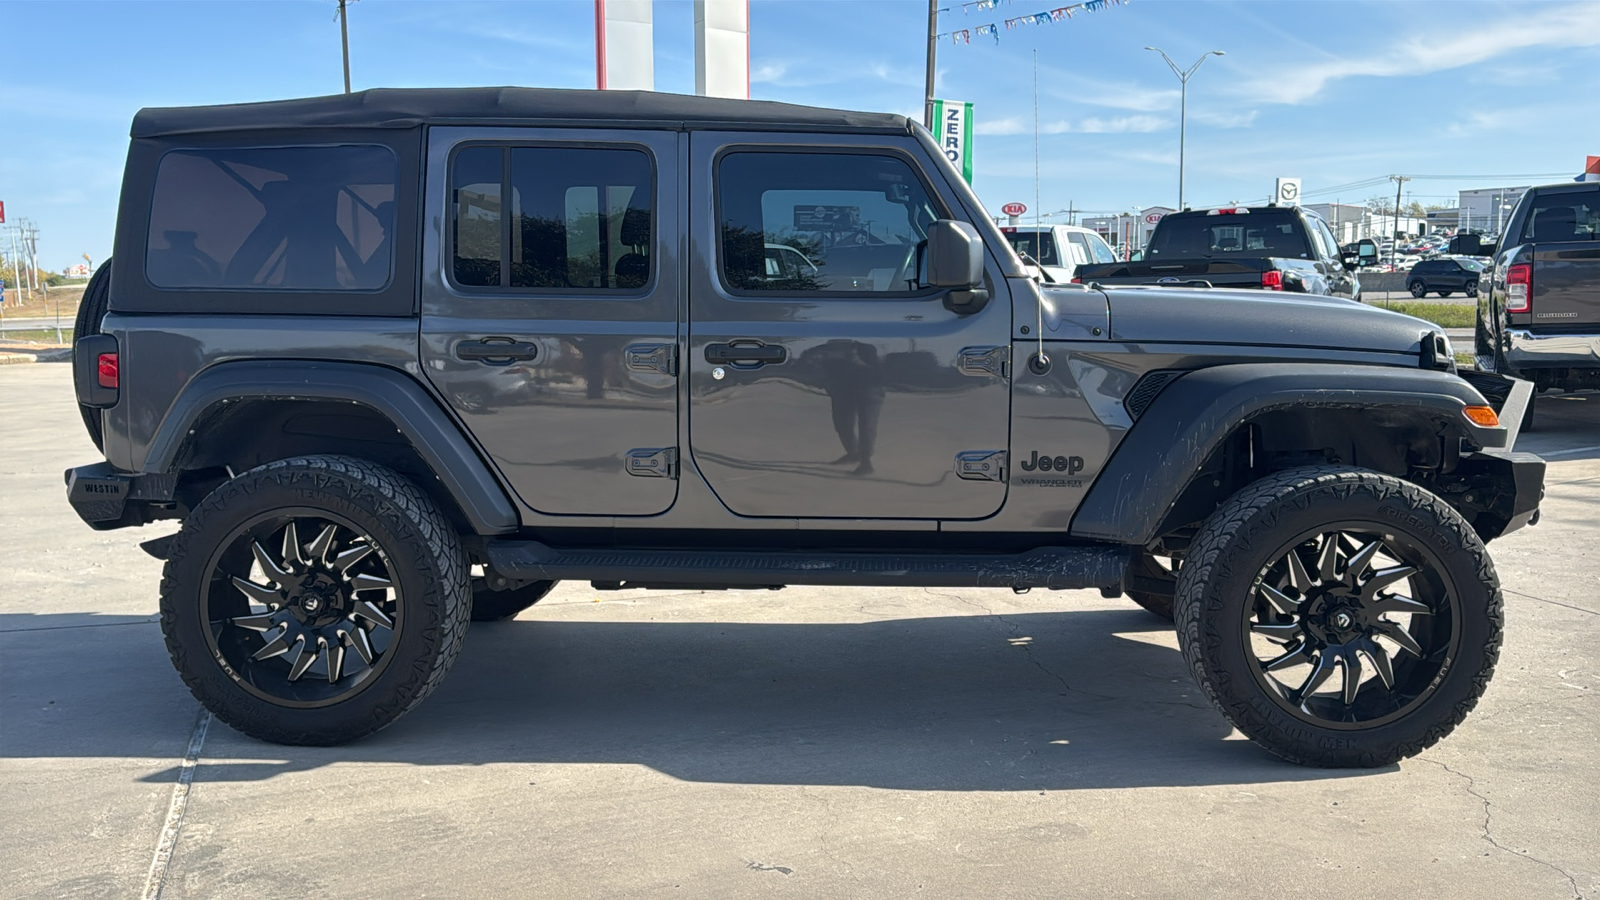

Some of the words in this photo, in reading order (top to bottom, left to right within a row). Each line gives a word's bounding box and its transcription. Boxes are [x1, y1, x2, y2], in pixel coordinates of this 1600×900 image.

[946, 109, 959, 162] ZERO
[1007, 205, 1024, 213] KIA
[1021, 451, 1084, 475] Jeep
[364, 534, 389, 567] FUEL
[1250, 561, 1275, 595] FUEL
[216, 649, 240, 682] FUEL
[1427, 657, 1451, 691] FUEL
